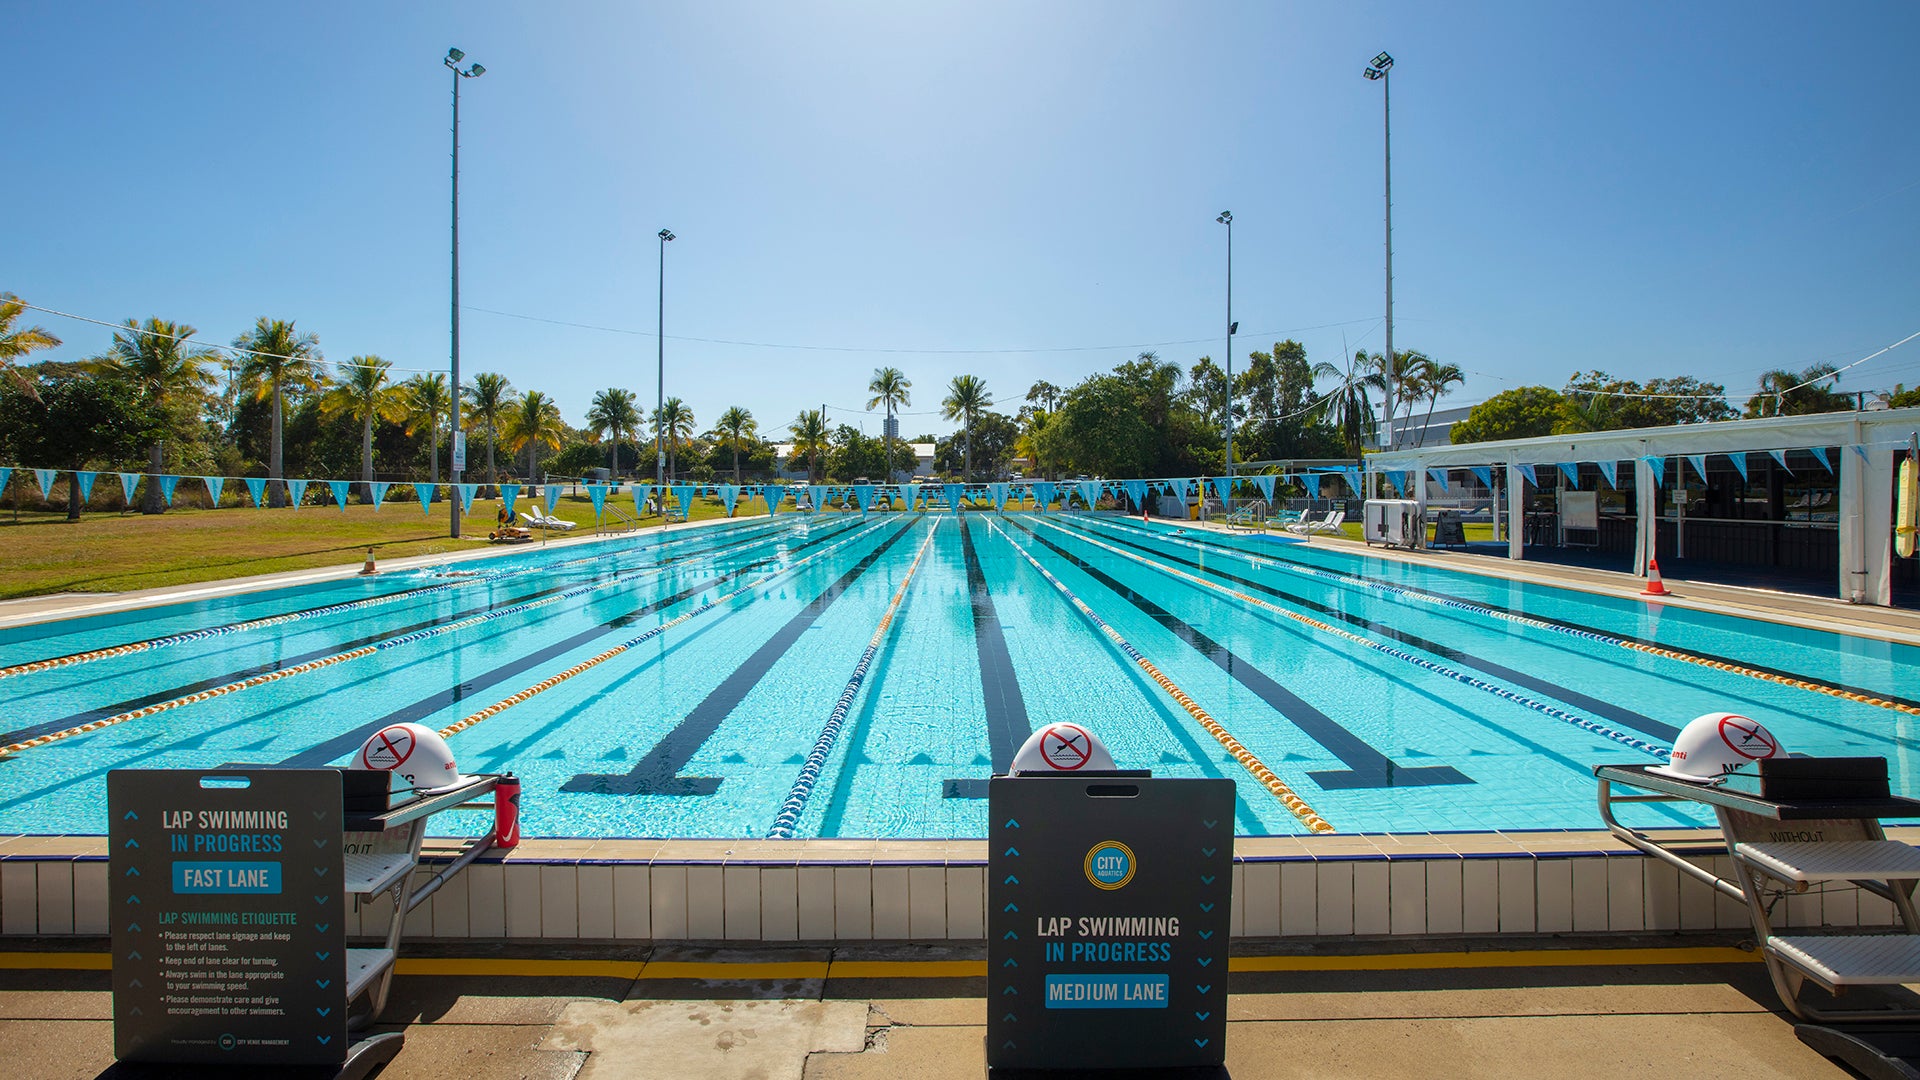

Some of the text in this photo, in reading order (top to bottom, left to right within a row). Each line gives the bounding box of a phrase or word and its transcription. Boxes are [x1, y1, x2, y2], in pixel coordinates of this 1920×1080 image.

[162, 810, 288, 829] LAP SWIMMING
[1768, 831, 1825, 842] WITHOUT
[171, 834, 282, 852] IN PROGRESS
[1097, 857, 1123, 870] CITY
[184, 869, 269, 887] FAST LANE
[159, 912, 297, 925] LAP SWIMMING ETIQUETTE
[1037, 917, 1180, 937] LAP SWIMMING
[164, 931, 291, 942] Please respect lane signage and keep
[166, 943, 229, 951] to the left of lanes.
[1046, 942, 1172, 962] IN PROGRESS
[165, 957, 279, 967] Keep end of lane clear for turning.
[165, 970, 284, 980] Always swim in the lane appropriate
[167, 981, 249, 991] to your swimming speed.
[1050, 983, 1165, 1000] MEDIUM LANE
[166, 995, 279, 1005] Please demonstrate care and give
[168, 1007, 285, 1016] encouragement to other swimmers.
